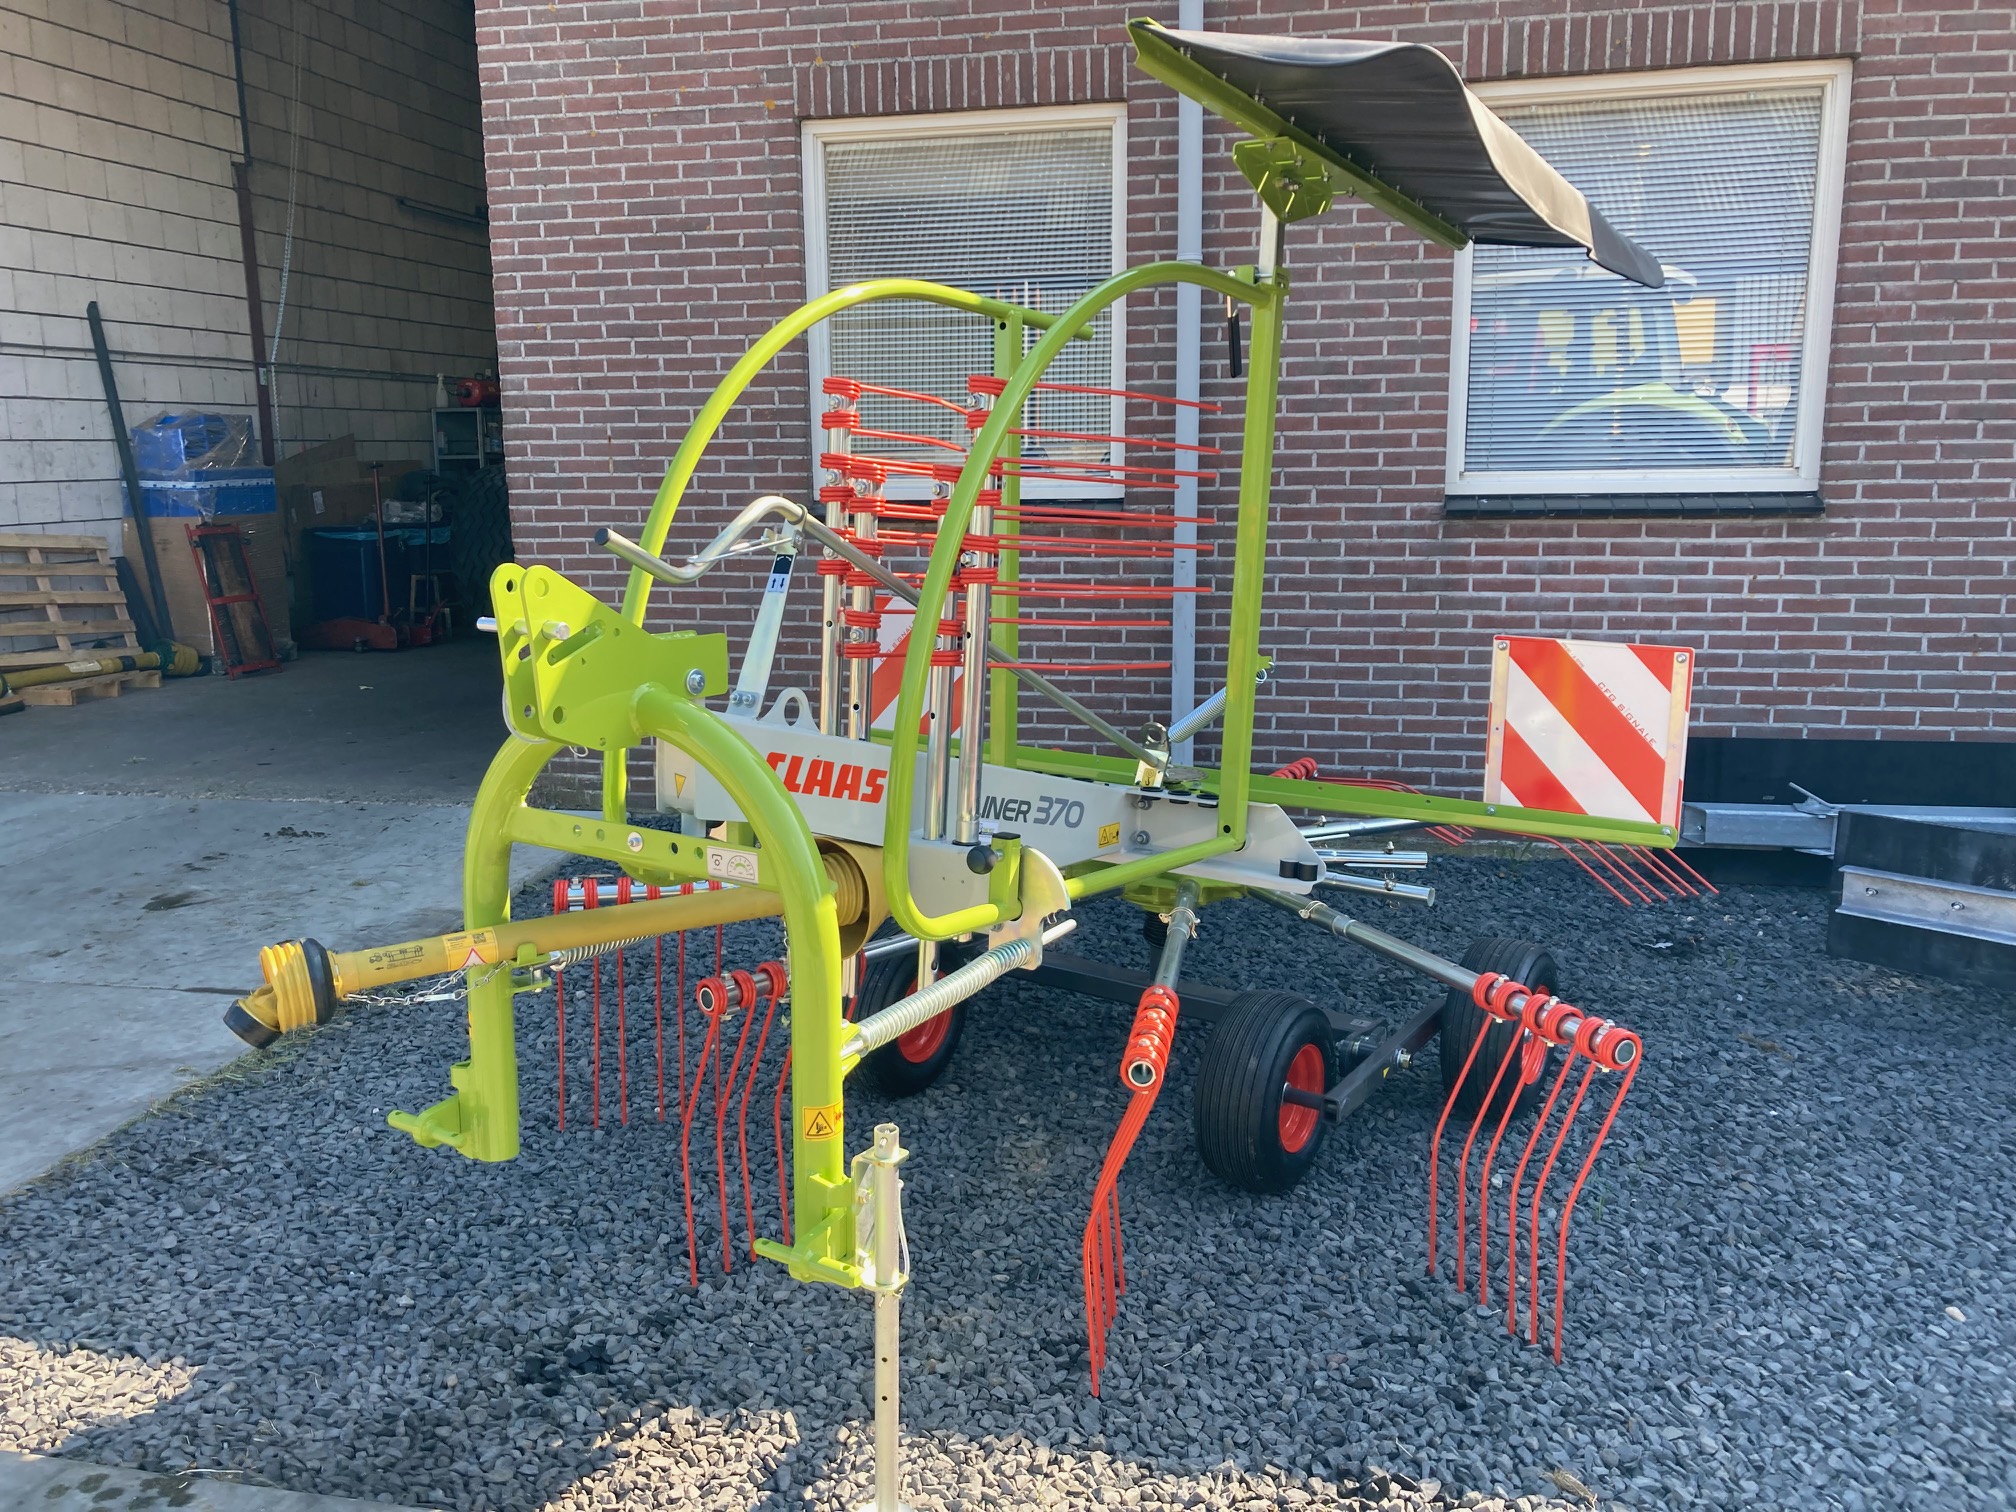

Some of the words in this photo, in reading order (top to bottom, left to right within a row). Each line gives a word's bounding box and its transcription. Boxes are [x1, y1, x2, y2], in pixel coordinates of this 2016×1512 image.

[1597, 681, 1617, 702] CFG
[978, 795, 1032, 824] INER
[1033, 795, 1085, 828] 370
